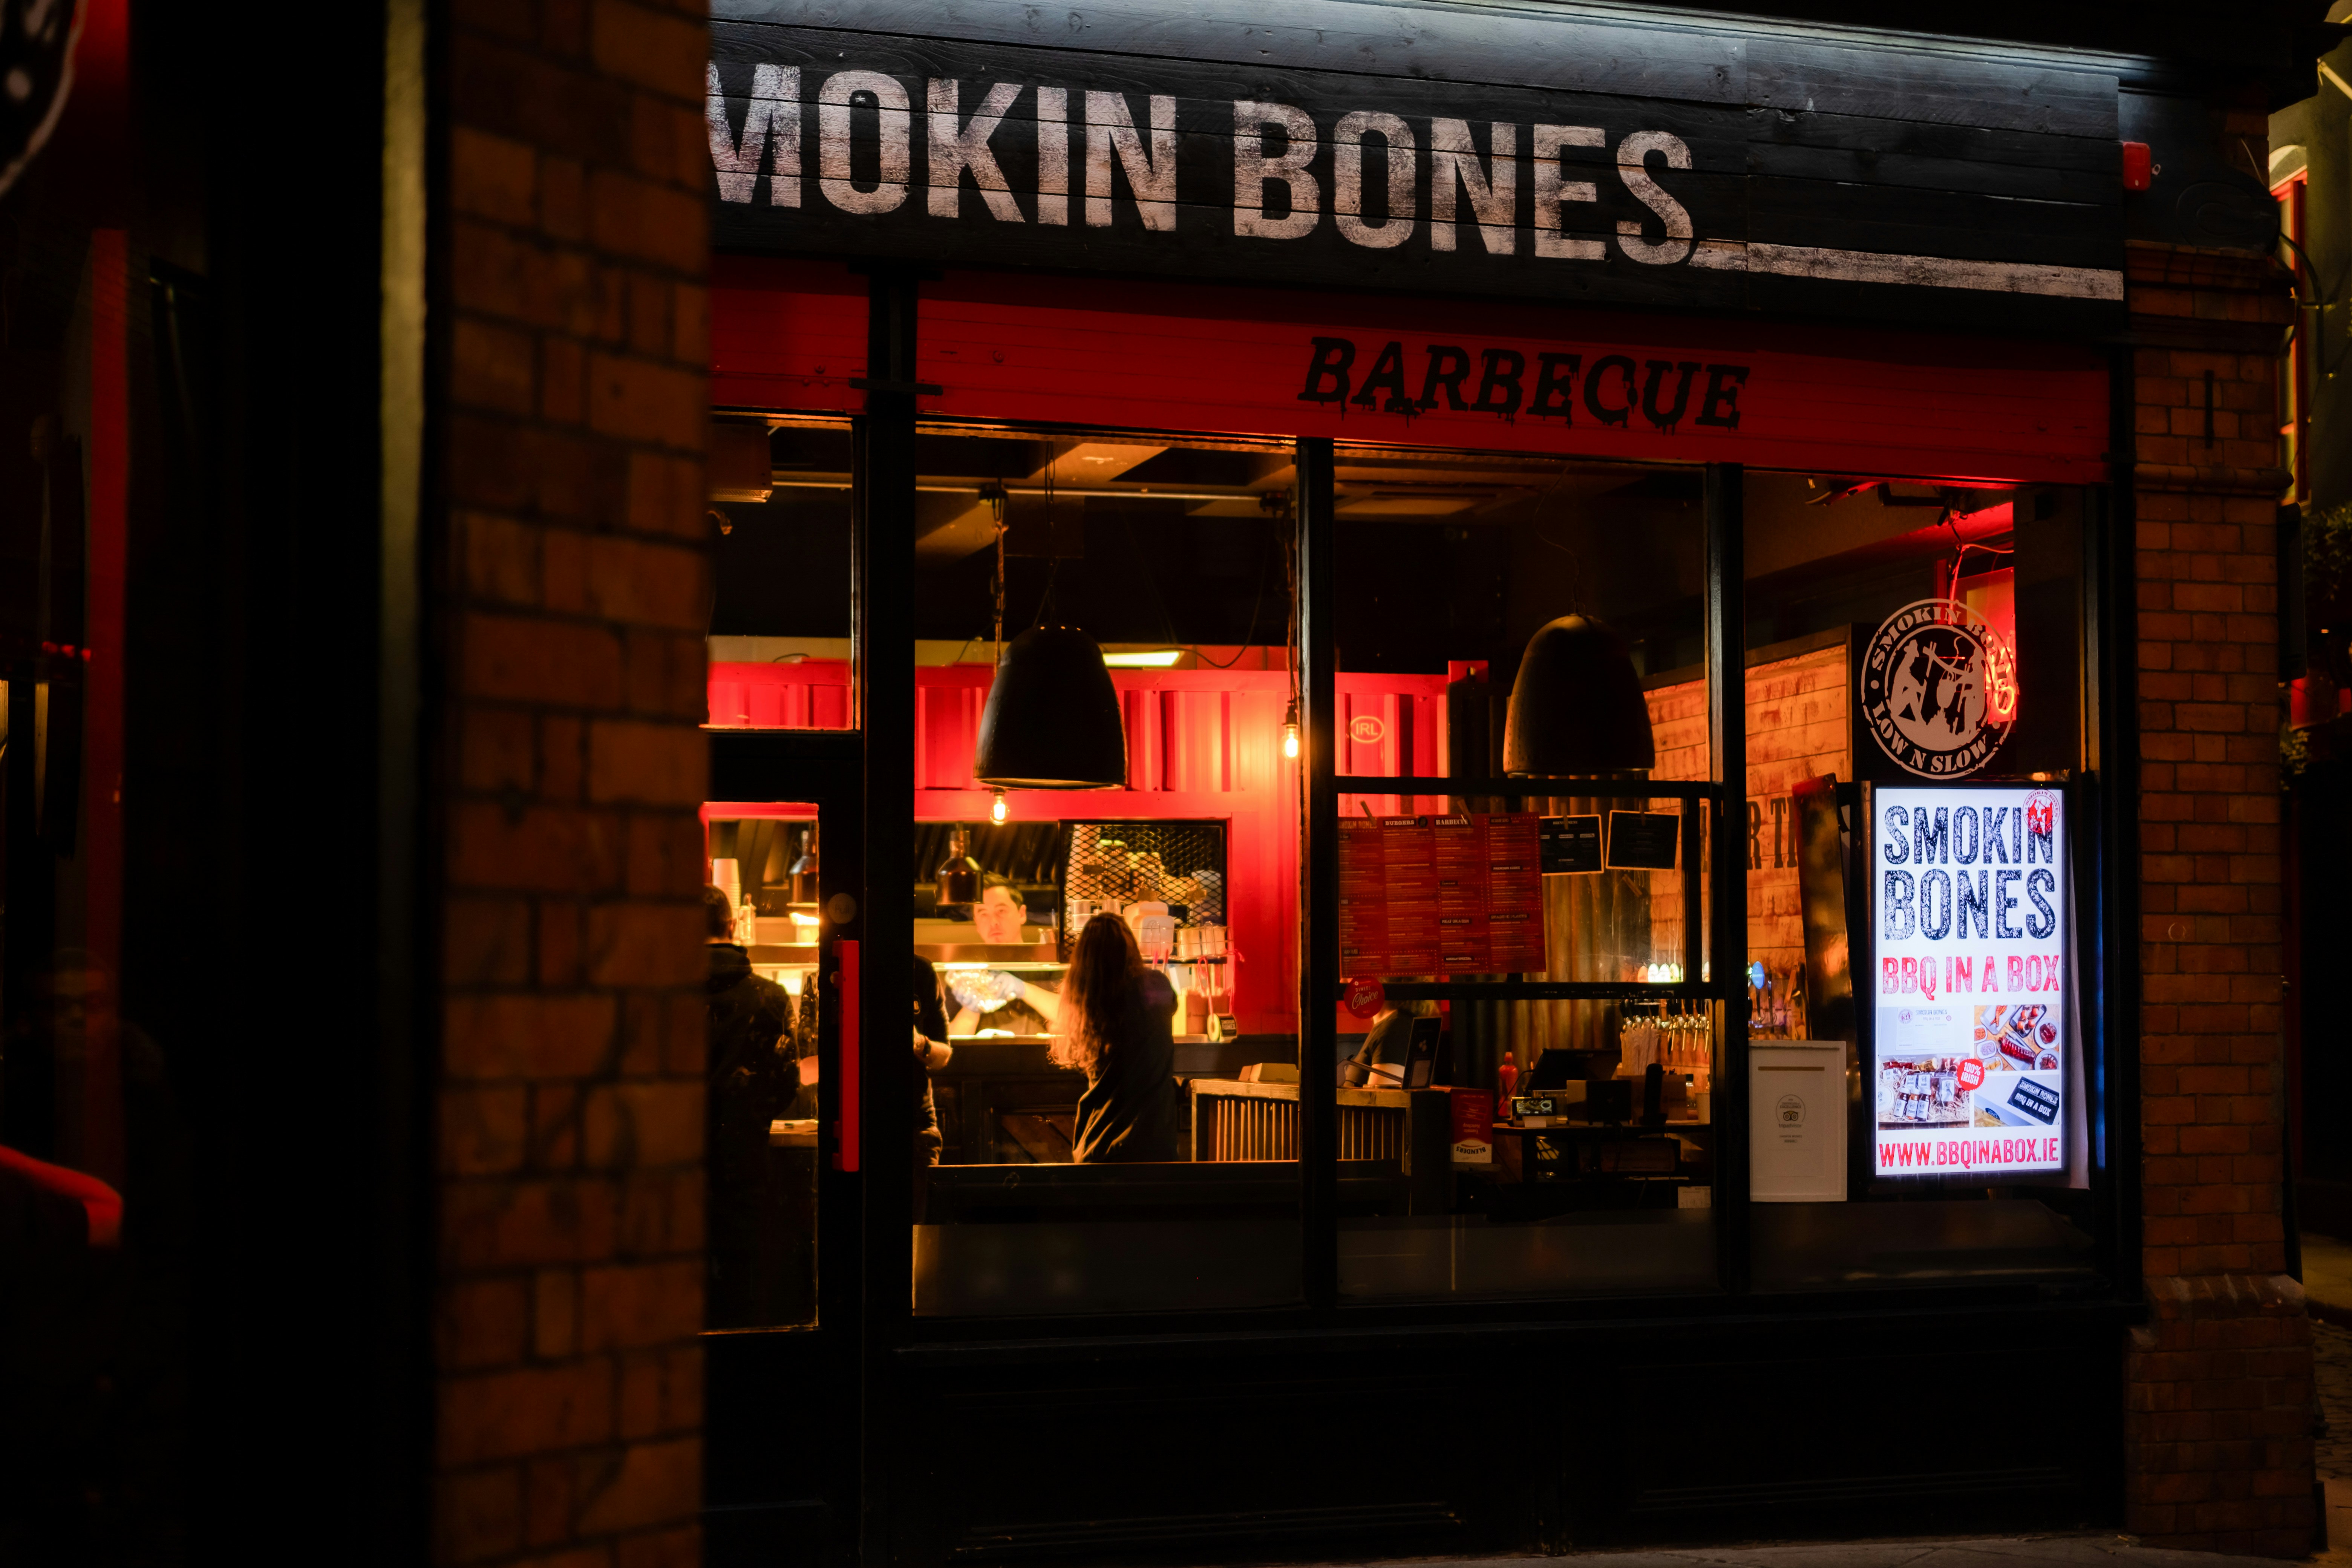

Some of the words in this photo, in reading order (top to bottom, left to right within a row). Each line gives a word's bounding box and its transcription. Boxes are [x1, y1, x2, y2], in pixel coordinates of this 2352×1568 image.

[1233, 98, 1692, 265] BONES
[1298, 336, 1749, 433] BARBECUE
[1872, 606, 1961, 671] SMOKIN
[1356, 723, 1378, 735] IRL
[1873, 701, 1909, 754] LOW
[1909, 748, 1926, 769] N
[1930, 735, 1987, 773] SLOW
[1884, 805, 2053, 864] SMOKIN
[1884, 868, 2056, 940] BONES
[1883, 956, 1936, 1000] BBQ
[1946, 956, 1972, 993] IN
[1981, 956, 1998, 992] A
[2007, 955, 2060, 992] BOX
[1352, 991, 1378, 1010] Choice
[1960, 1071, 1980, 1086] IRISH
[1963, 1062, 1981, 1076] 100%
[2014, 1092, 2027, 1106] BBQ
[2026, 1099, 2034, 1107] IN
[2033, 1102, 2039, 1110] A
[2038, 1104, 2052, 1117] BOX
[2019, 1081, 2039, 1096] SMOKIN
[2040, 1090, 2059, 1105] BONES
[1456, 1146, 1486, 1154] BLENDERS
[1879, 1138, 2058, 1169] WWW.BBQINABOX.IE
